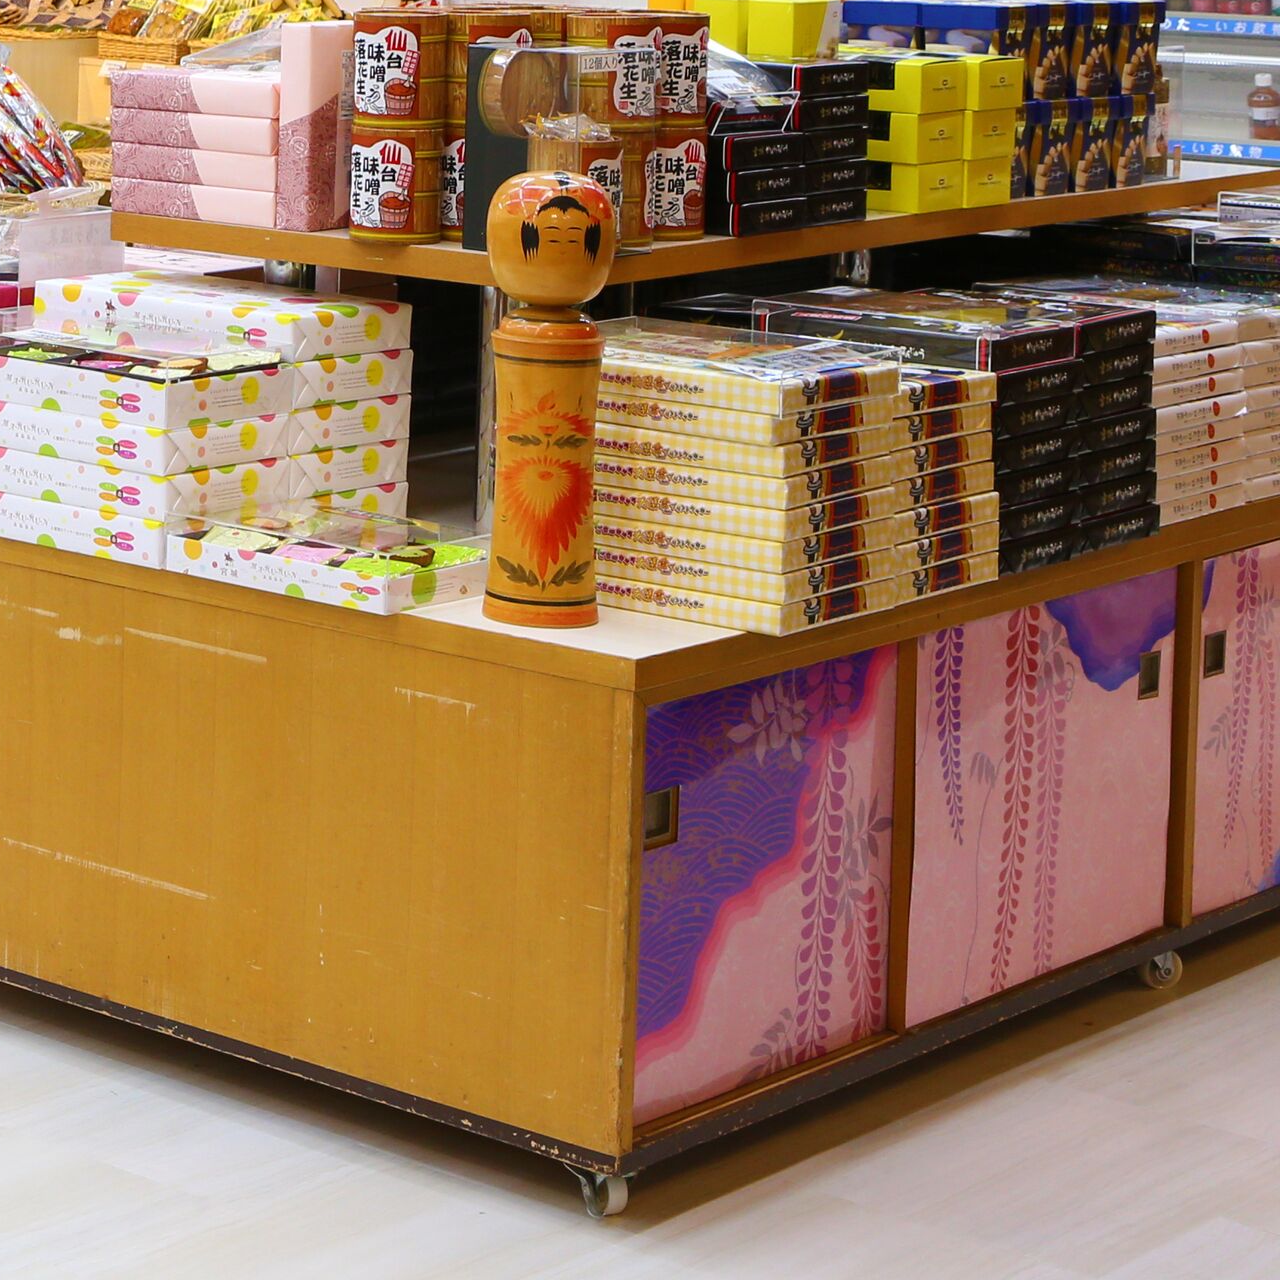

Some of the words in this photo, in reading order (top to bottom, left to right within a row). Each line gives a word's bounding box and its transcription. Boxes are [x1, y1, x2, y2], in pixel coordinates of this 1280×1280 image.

[354, 38, 368, 96] 落花生
[368, 42, 386, 84] 味噌
[385, 28, 407, 69] 仙台
[582, 56, 618, 70] 12個入り
[683, 44, 700, 83] 味噌
[351, 152, 363, 210] 落花生
[363, 156, 381, 196] 味噌
[380, 142, 402, 183] 仙台
[665, 157, 685, 195] 味噌
[685, 141, 701, 181] 仙台
